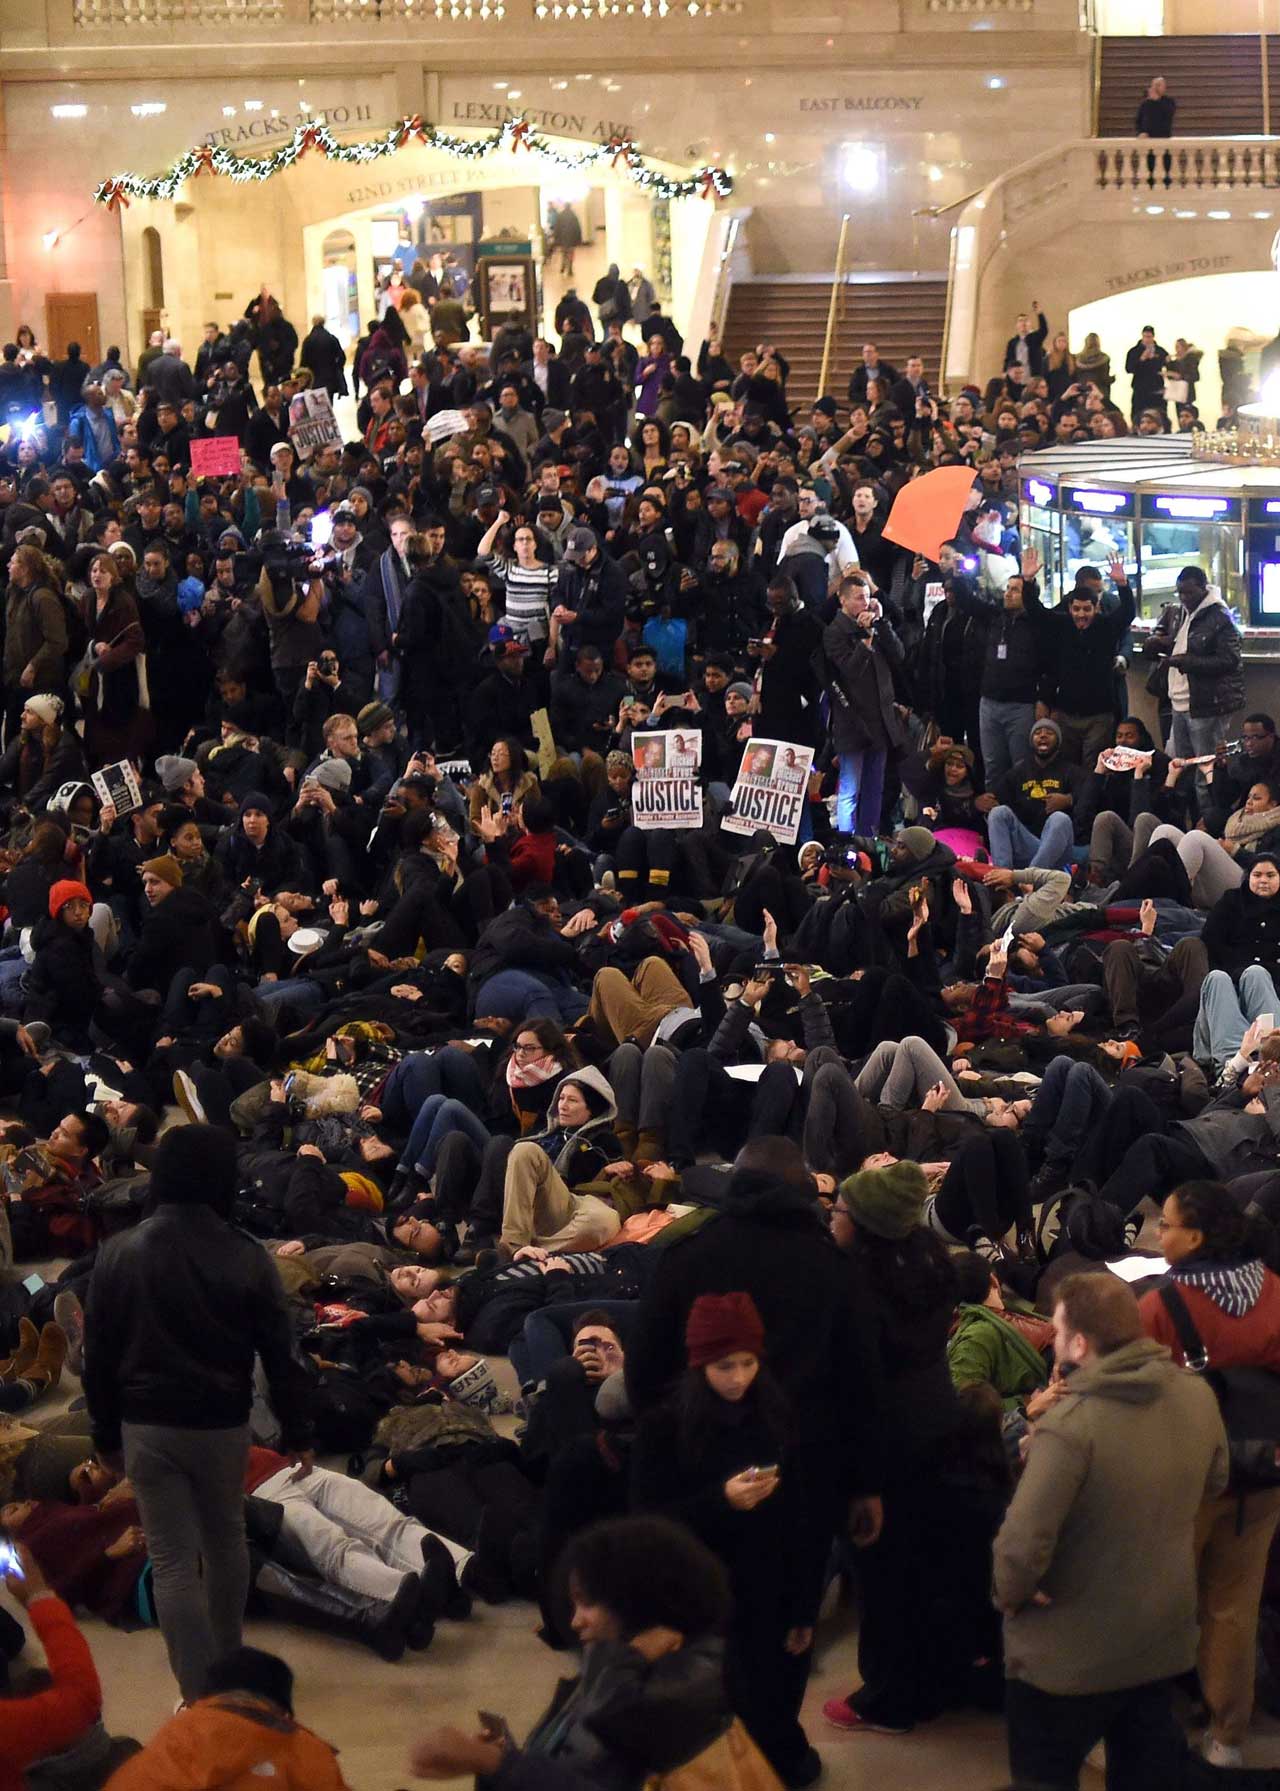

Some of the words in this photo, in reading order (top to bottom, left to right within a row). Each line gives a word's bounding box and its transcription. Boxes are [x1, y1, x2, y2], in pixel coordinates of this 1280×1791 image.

[453, 102, 586, 134] LEXINGTON
[593, 121, 634, 138] AVE
[800, 98, 840, 111] EAST
[844, 97, 924, 111] BALCONY
[205, 115, 290, 146] TRACKS
[319, 107, 349, 125] TO
[347, 183, 393, 204] 42ND
[398, 170, 459, 191] STREET
[1104, 266, 1163, 289] TRACKS
[1187, 257, 1210, 271] TO
[296, 419, 341, 447] JUSTICE
[635, 780, 699, 812] JUSTICE
[732, 785, 801, 827] JUSTICE
